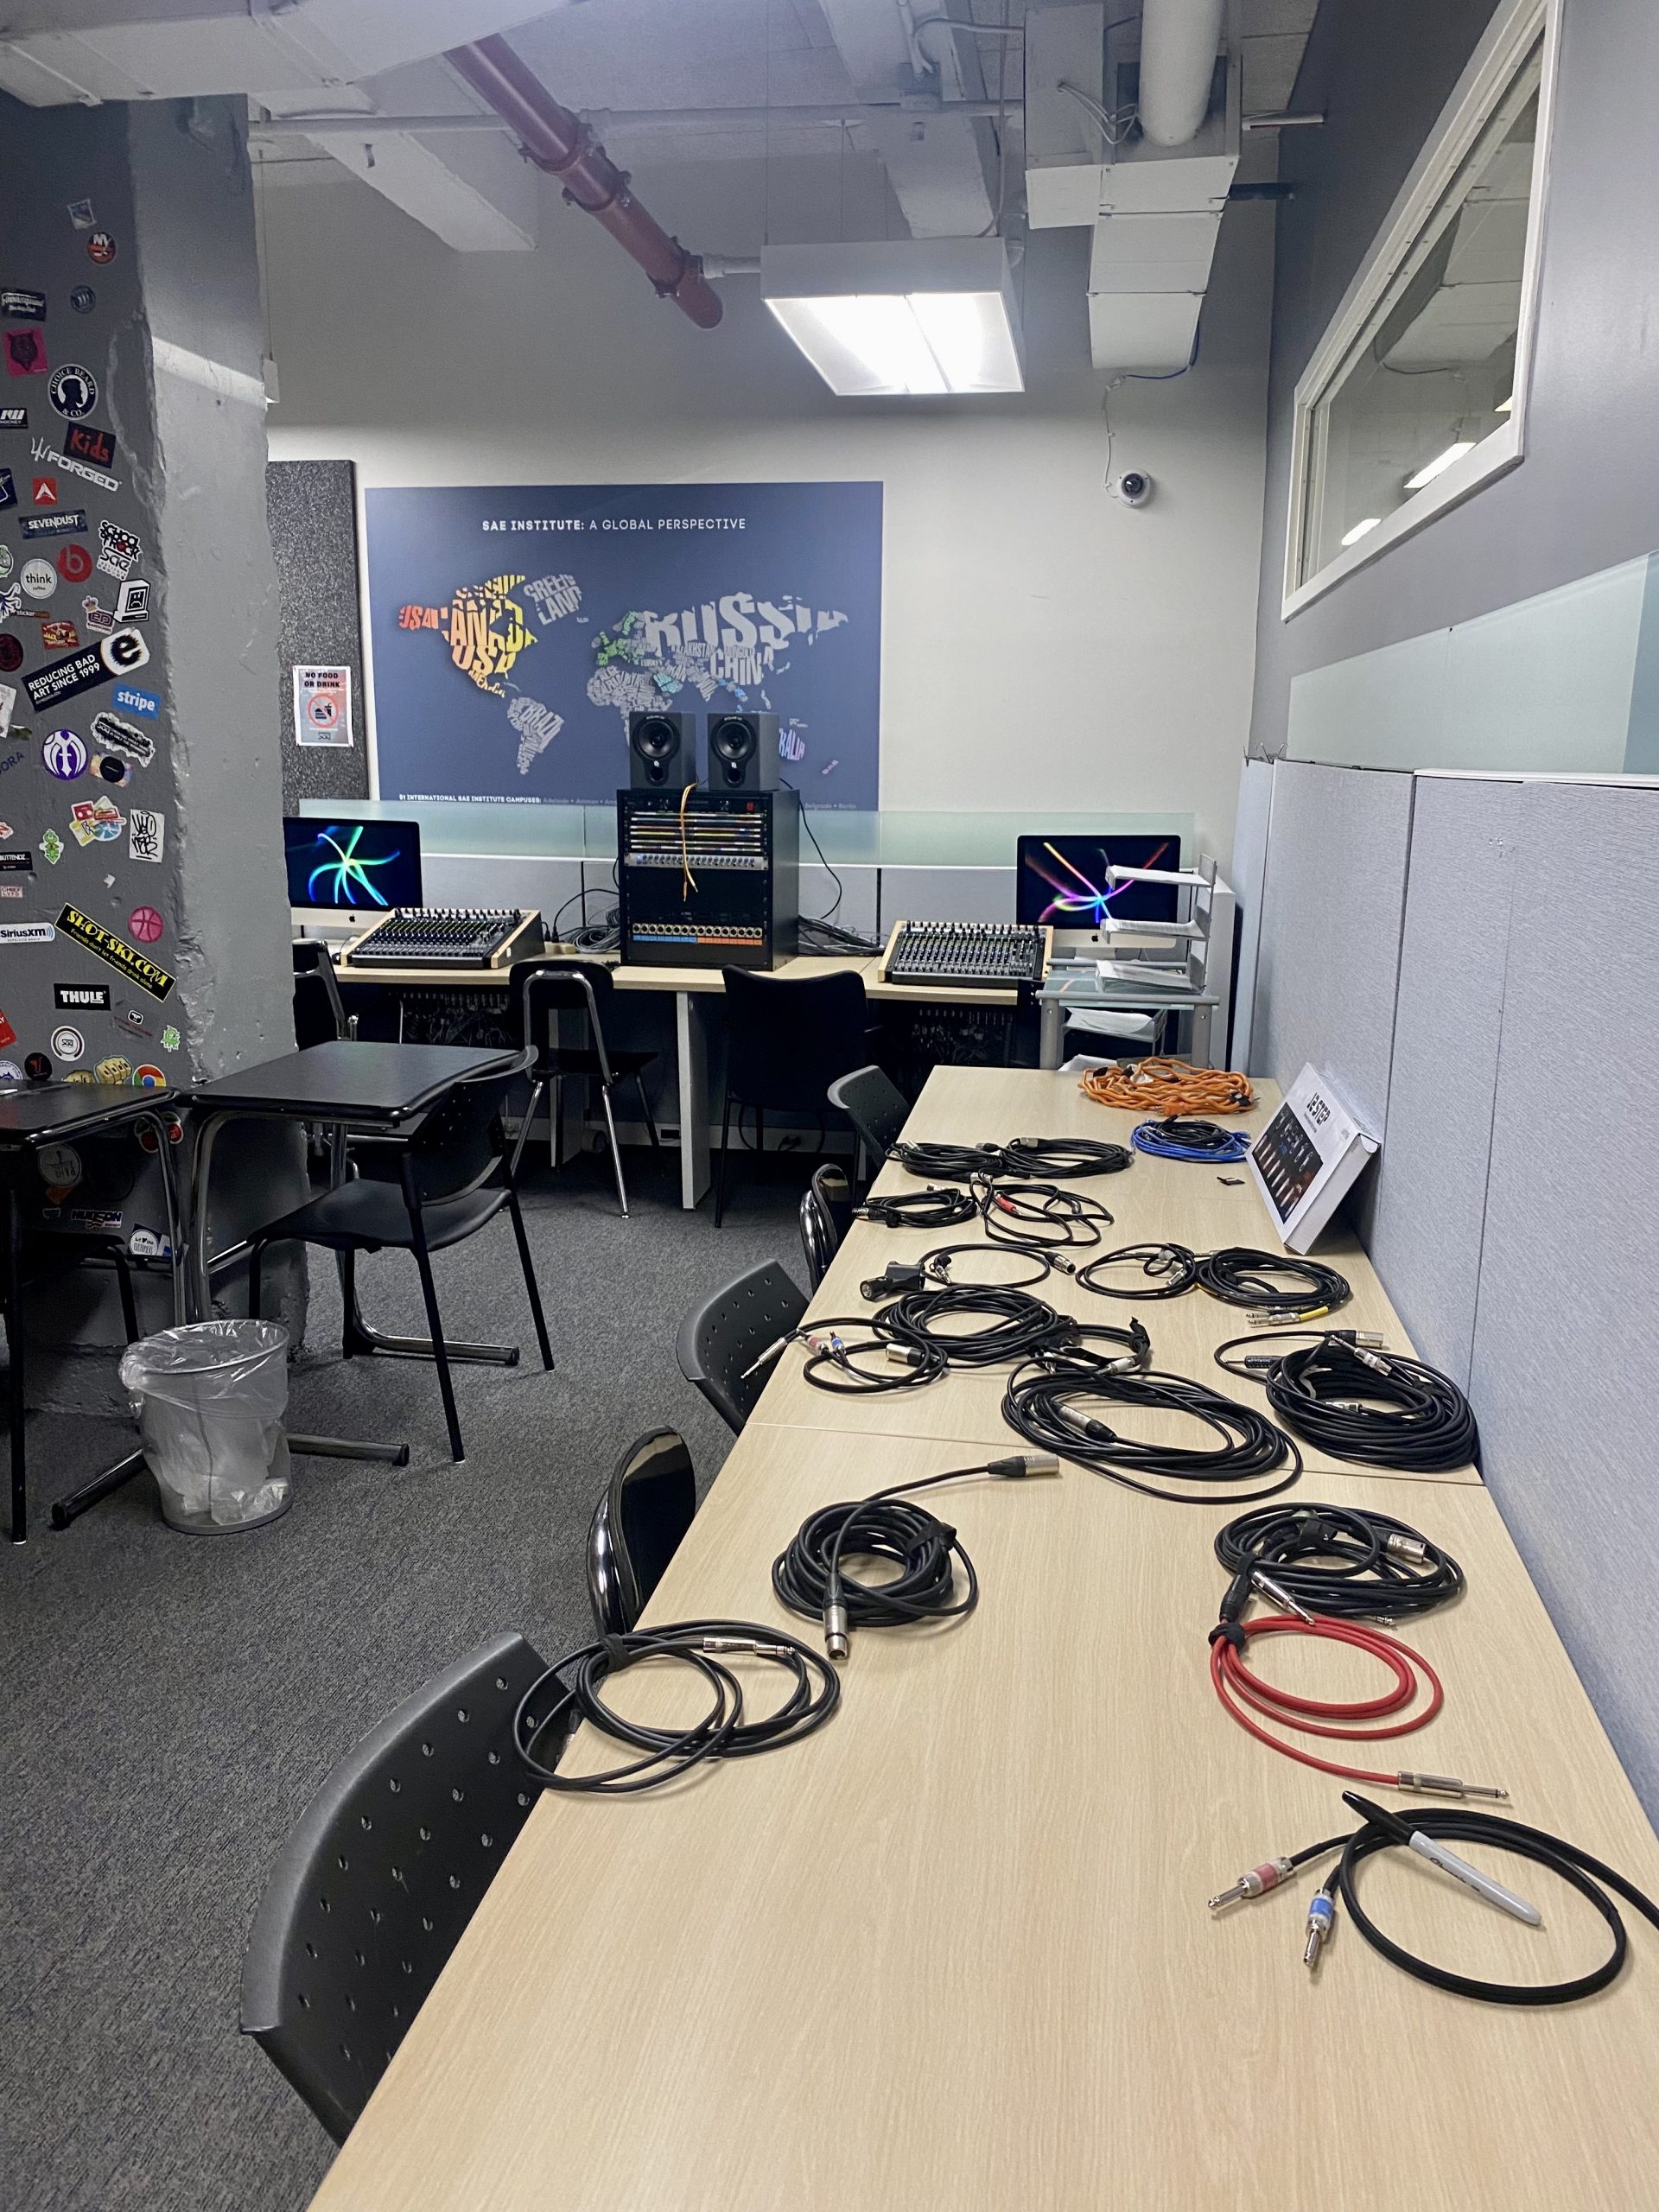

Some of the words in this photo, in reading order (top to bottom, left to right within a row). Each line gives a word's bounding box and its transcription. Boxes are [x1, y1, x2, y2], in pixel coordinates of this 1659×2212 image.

[51, 367, 72, 394] CHOICE
[74, 367, 94, 395] BEARD
[71, 429, 109, 462] Kids
[48, 450, 119, 493] FORGED
[29, 515, 79, 530] SEVENDUST
[482, 520, 506, 531] SAE
[511, 520, 584, 531] INSTITUTE:
[589, 520, 598, 531] A
[602, 519, 653, 531] GLOBAL
[658, 518, 746, 530] PERSPECTIVE
[26, 574, 52, 584] think
[643, 592, 849, 658] RUSSIA
[29, 664, 74, 691] REDUCING
[75, 654, 96, 671] BAD
[34, 686, 52, 701] ART
[52, 672, 79, 691] SINCE
[79, 663, 100, 678] 1999
[117, 691, 156, 711] stripe
[779, 728, 805, 761] RALIA
[0, 751, 25, 773] ORA
[67, 910, 168, 988] SHOT-SKI.COM
[60, 990, 104, 1004] THULE
[140, 977, 153, 989] alone
